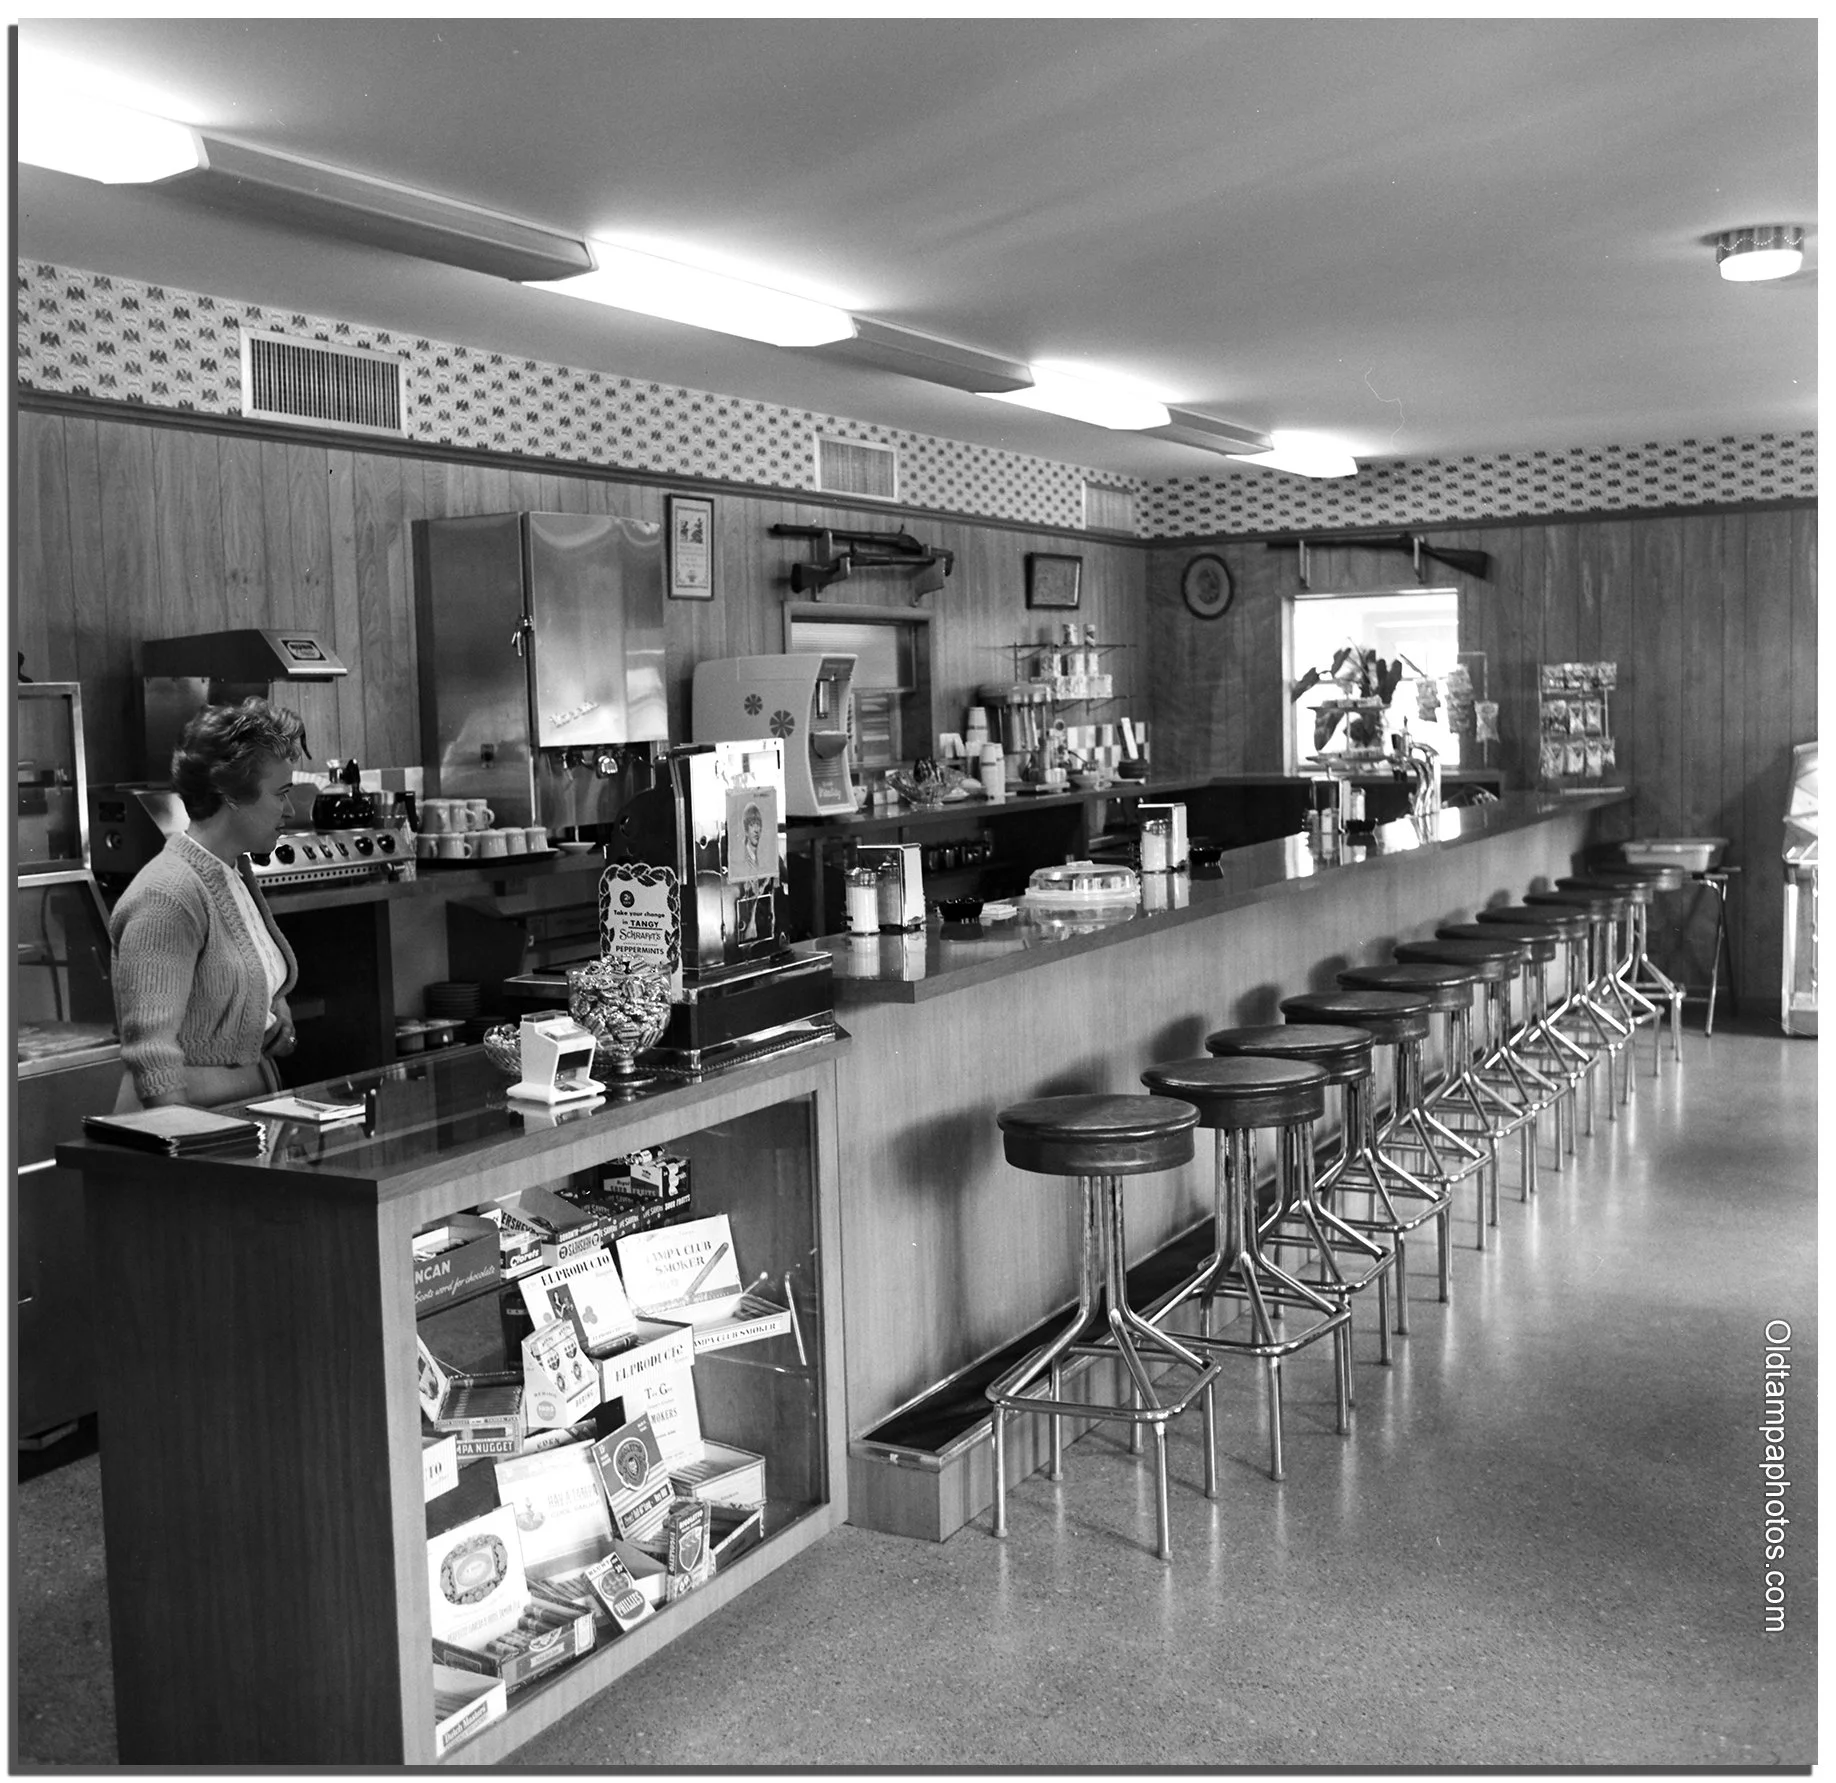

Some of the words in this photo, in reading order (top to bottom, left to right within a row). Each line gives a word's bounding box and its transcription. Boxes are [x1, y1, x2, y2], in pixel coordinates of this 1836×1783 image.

[615, 946, 665, 955] PEPPERMINTS
[509, 1248, 540, 1268] Clorets
[684, 1241, 713, 1257] CLUB
[465, 1264, 496, 1285] chocolate
[541, 1274, 556, 1287] EL
[555, 1255, 611, 1281] PRODUCTO
[655, 1256, 706, 1275] SMOKER
[739, 1323, 777, 1338] SMOKER
[615, 1367, 629, 1383] EL
[630, 1344, 684, 1376] PRODUCTO
[476, 1441, 514, 1456] NUGGET
[614, 1590, 645, 1617] PHILLIES
